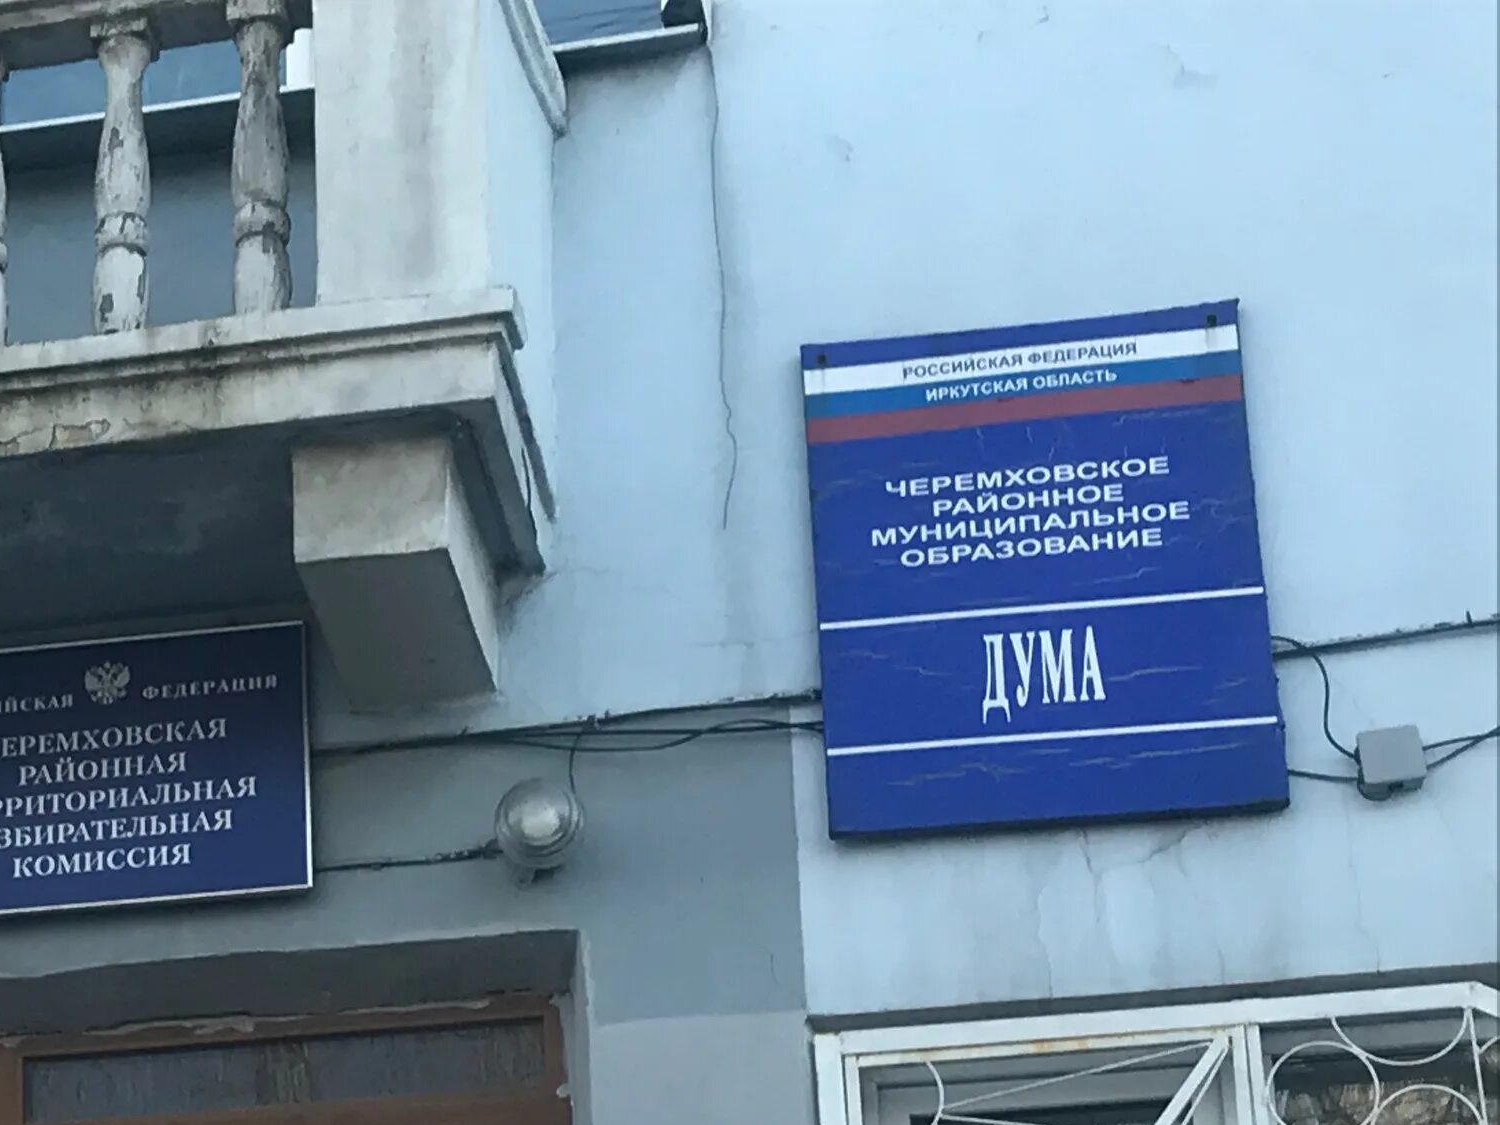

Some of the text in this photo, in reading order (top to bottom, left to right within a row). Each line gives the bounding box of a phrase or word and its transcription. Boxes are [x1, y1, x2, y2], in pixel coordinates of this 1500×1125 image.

[903, 341, 1138, 380] РОССИЙСКАЯ ФЕДЕРАЦИЯ
[925, 368, 1118, 403] ИРКУТСКАЯ ОБЛАСТЬ
[885, 456, 1170, 498] ЧЕРЕМХОВСКОЕ
[932, 484, 1125, 517] РАЙОННОЕ
[871, 501, 1191, 547] МУНИЦИПАЛЬНОЕ
[900, 528, 1164, 567] ОБРАЗОВАНИЕ
[142, 674, 279, 701] ФЕДЕРАЦИЯ
[983, 626, 1106, 724] ДУМА
[18, 751, 188, 787] РАЙОННАЯ
[12, 843, 192, 878] КОМИССИЯ
